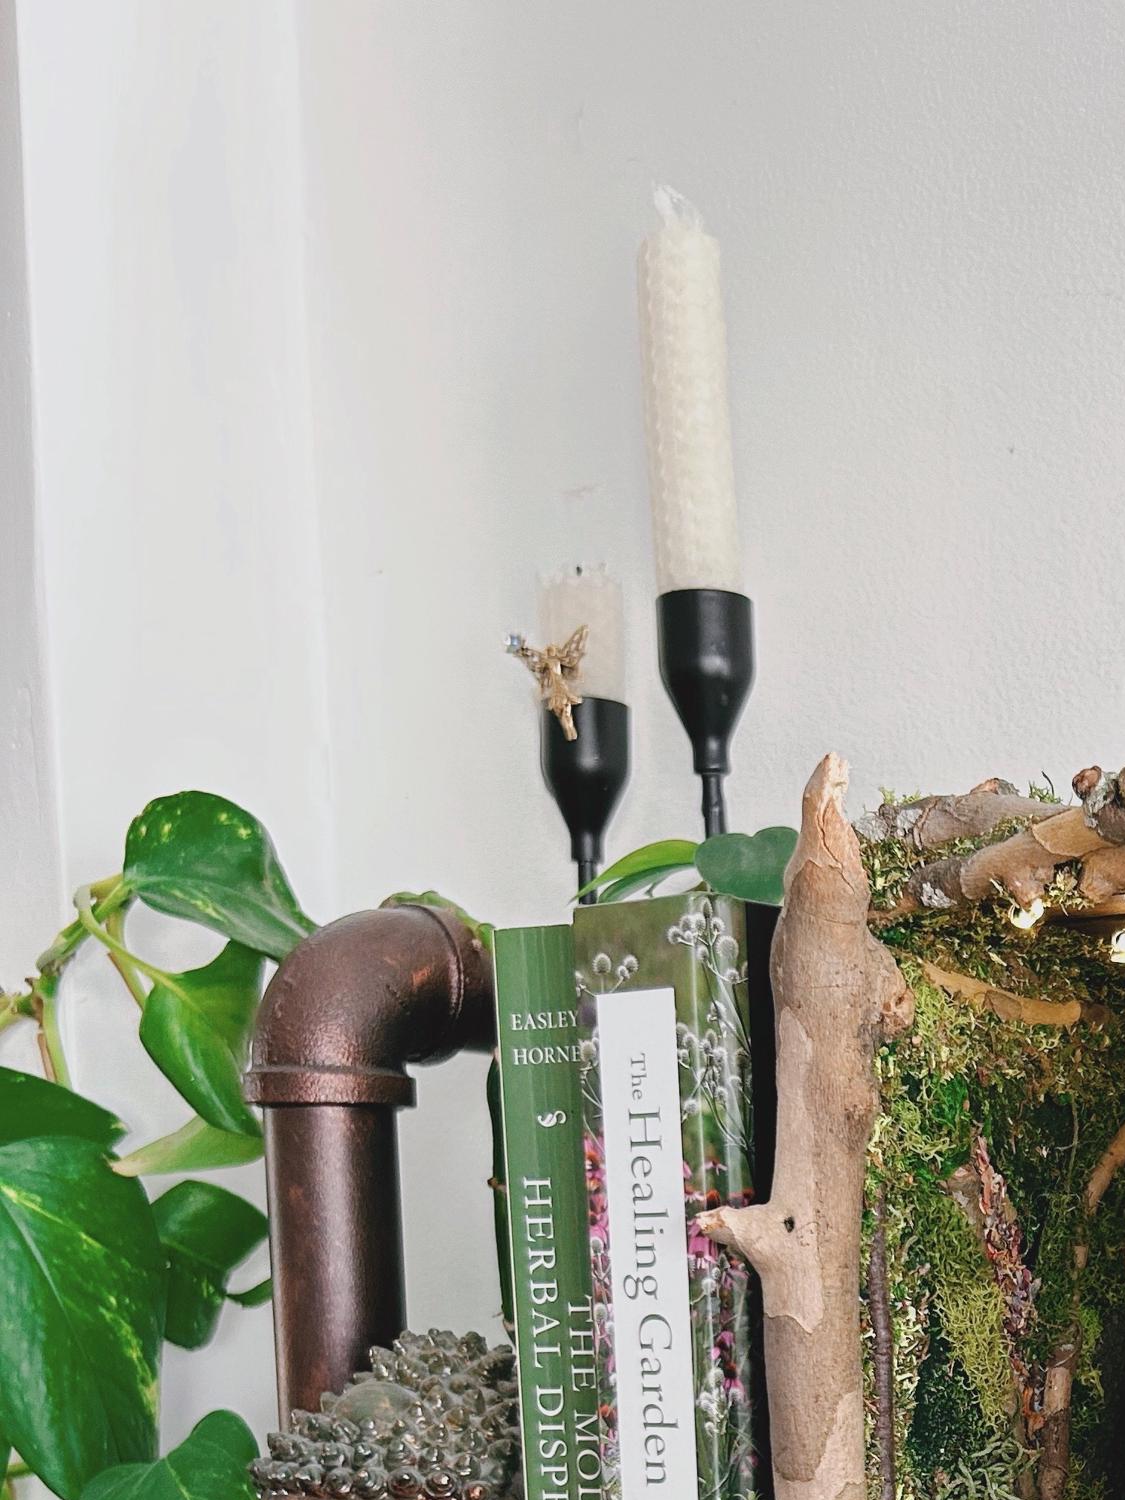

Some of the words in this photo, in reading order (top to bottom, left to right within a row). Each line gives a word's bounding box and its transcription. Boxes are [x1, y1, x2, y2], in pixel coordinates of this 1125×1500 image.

[511, 1010, 578, 1031] EASLEY
[513, 1045, 581, 1065] HORNE
[630, 1052, 647, 1100] The
[624, 1106, 669, 1299] Healing
[523, 1176, 562, 1368] HERBAL
[568, 1294, 597, 1392] THE
[639, 1313, 679, 1487] Garden
